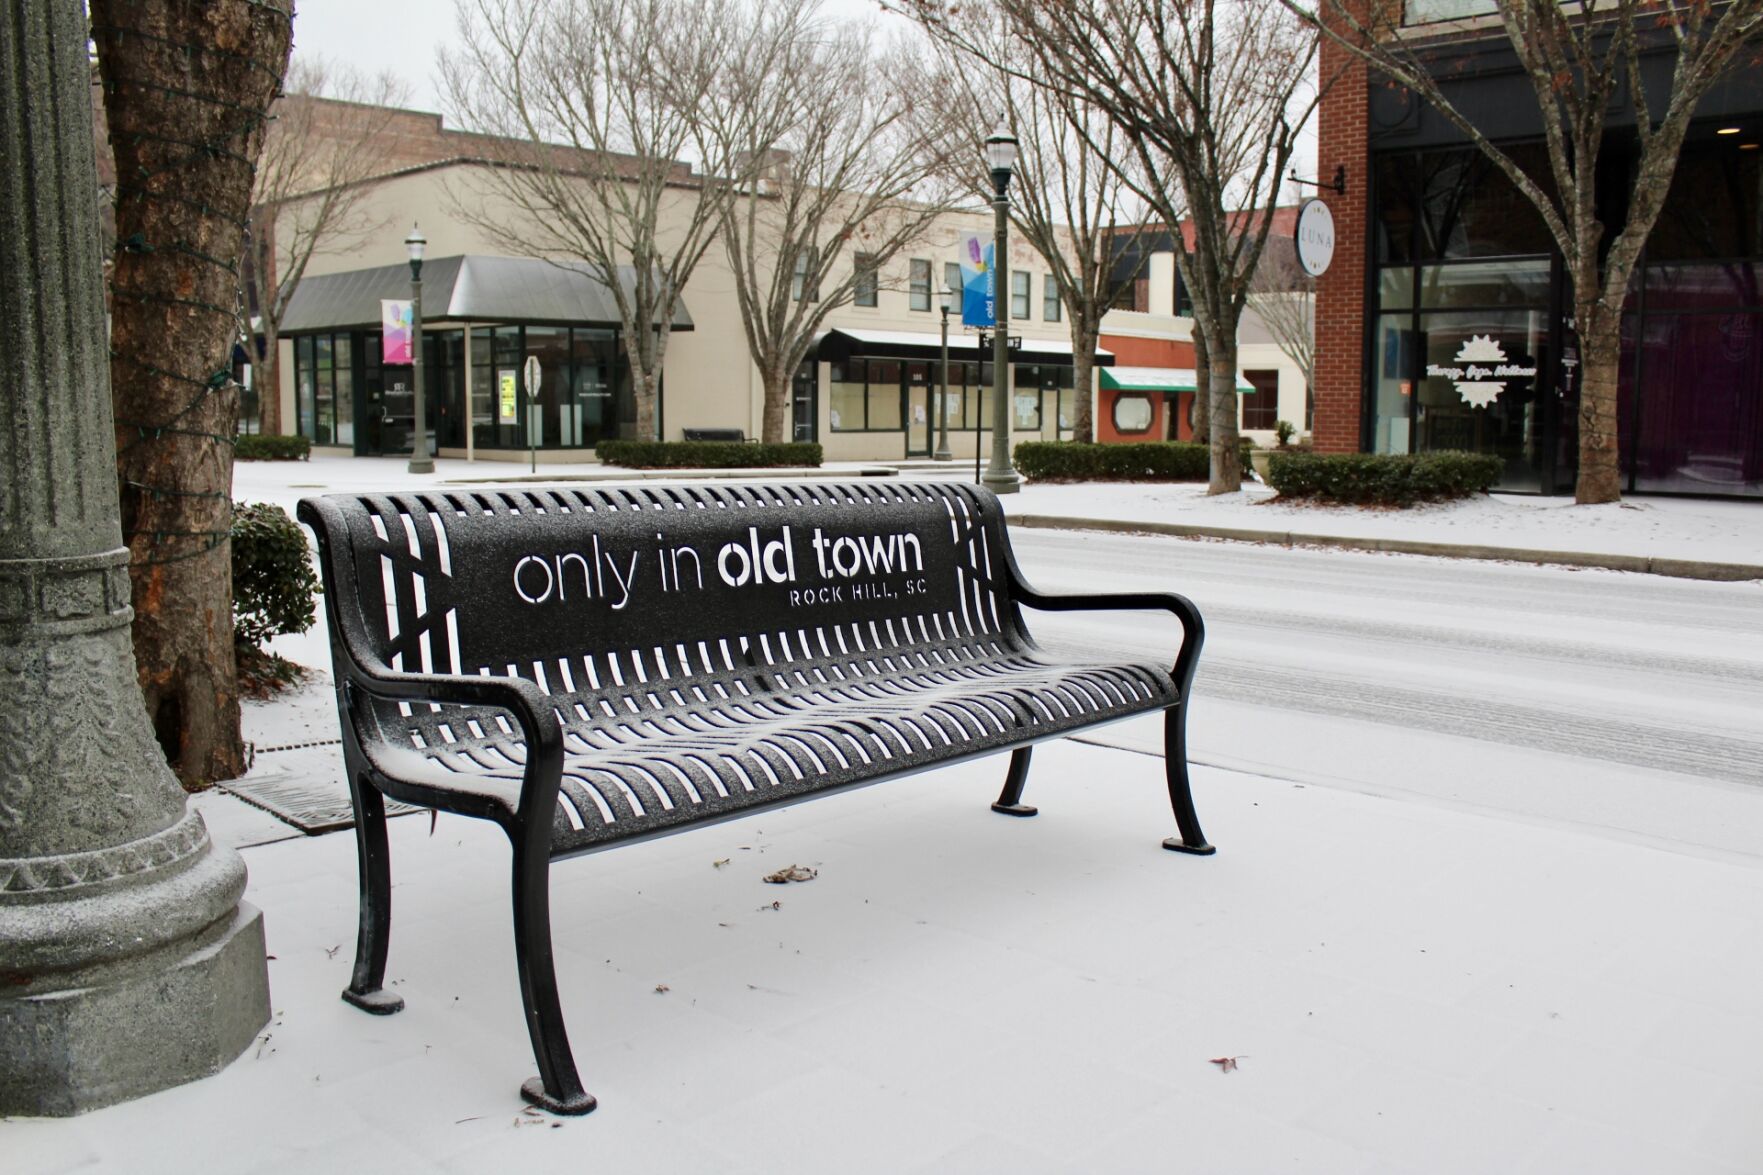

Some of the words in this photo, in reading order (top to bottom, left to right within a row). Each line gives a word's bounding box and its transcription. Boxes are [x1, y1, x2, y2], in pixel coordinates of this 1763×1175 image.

[1301, 226, 1332, 249] LUNA
[986, 301, 994, 319] old
[513, 534, 638, 610] only
[656, 532, 703, 592] in
[717, 525, 796, 588] old
[812, 528, 924, 579] town
[789, 586, 843, 607] ROCK
[852, 582, 898, 600] HILL,
[906, 578, 927, 595] SC
